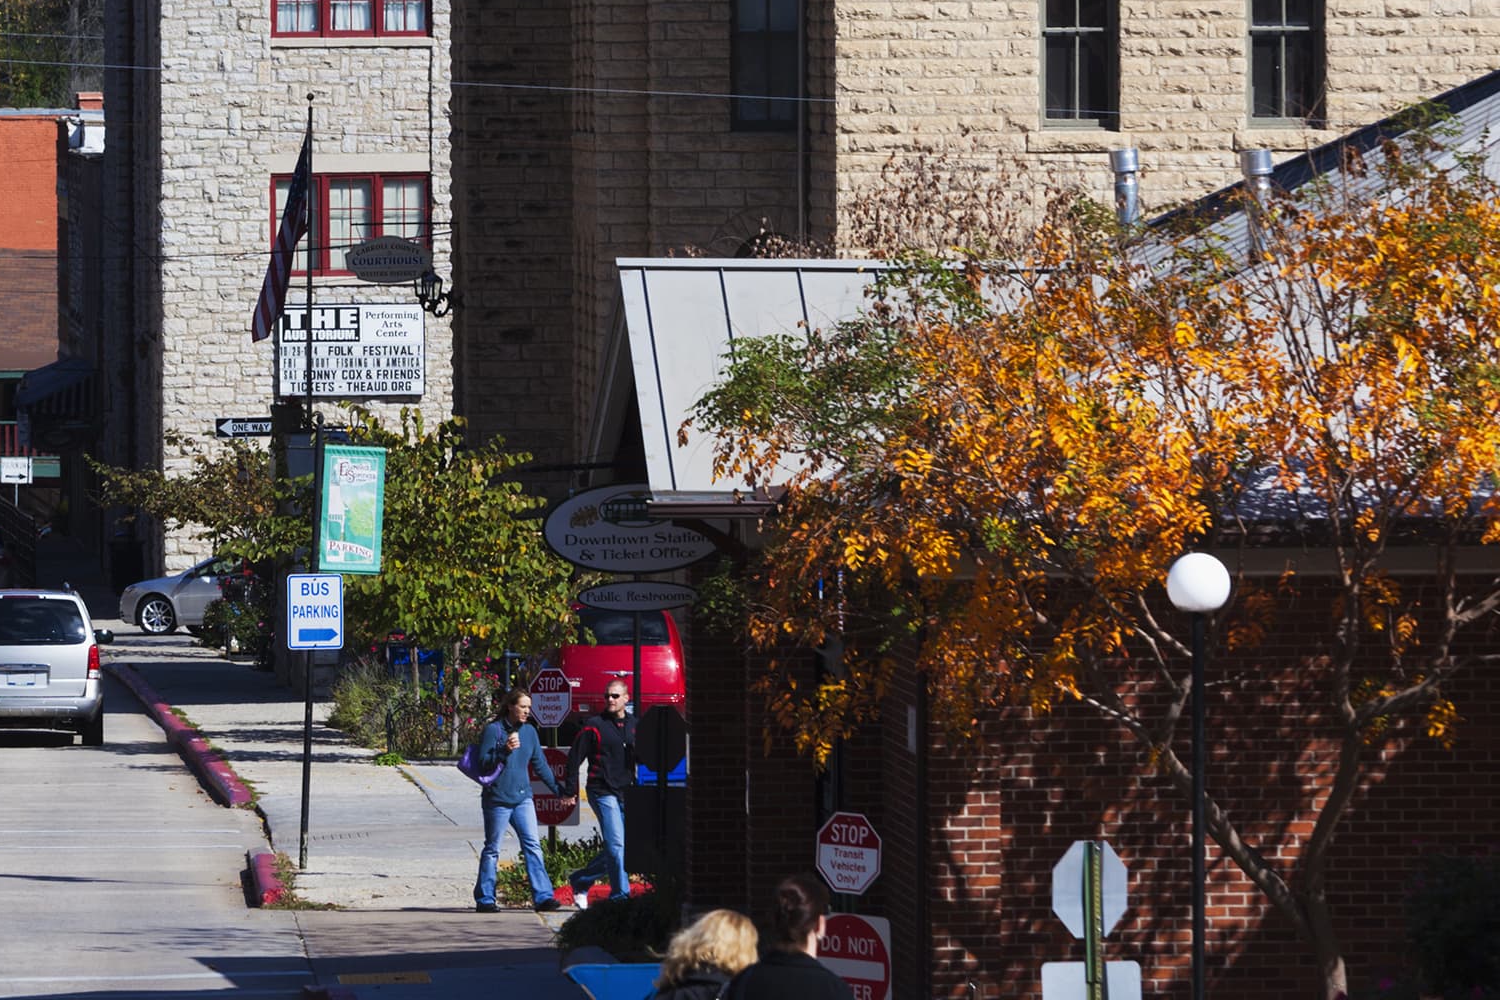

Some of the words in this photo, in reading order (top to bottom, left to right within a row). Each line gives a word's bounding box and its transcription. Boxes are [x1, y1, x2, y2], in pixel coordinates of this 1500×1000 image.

[352, 256, 425, 266] COURTHOUSE
[284, 309, 358, 329] THE
[365, 311, 419, 321] Performing
[381, 320, 403, 329] Arts
[284, 329, 359, 341] AUDTORIUM.
[375, 329, 409, 338] Center
[328, 346, 354, 357] FOLK
[336, 358, 368, 368] FISHING
[373, 357, 381, 368] IN
[386, 357, 420, 368] AMERICA
[341, 369, 363, 380] COX
[365, 369, 373, 379] &
[376, 368, 421, 380] FRIENDS
[231, 423, 249, 432] ONE
[251, 422, 270, 432] WAY
[564, 534, 649, 547] Downtown
[653, 531, 712, 545] Station
[329, 540, 373, 559] PARKING
[579, 550, 596, 562] &
[603, 548, 646, 560] Ticket
[650, 546, 697, 560] Office
[301, 582, 330, 596] BUS
[586, 591, 621, 603] Public
[626, 588, 693, 601] Restrooms
[292, 604, 339, 618] PARKING
[537, 676, 564, 692] STOP
[539, 693, 561, 702] Transit
[537, 703, 562, 712] Vehicles
[831, 824, 869, 844] STOP
[834, 847, 864, 860] Transit
[830, 860, 867, 874] Vehicles
[836, 873, 860, 885] Only!
[820, 935, 841, 953] DO
[848, 935, 876, 957] NOT
